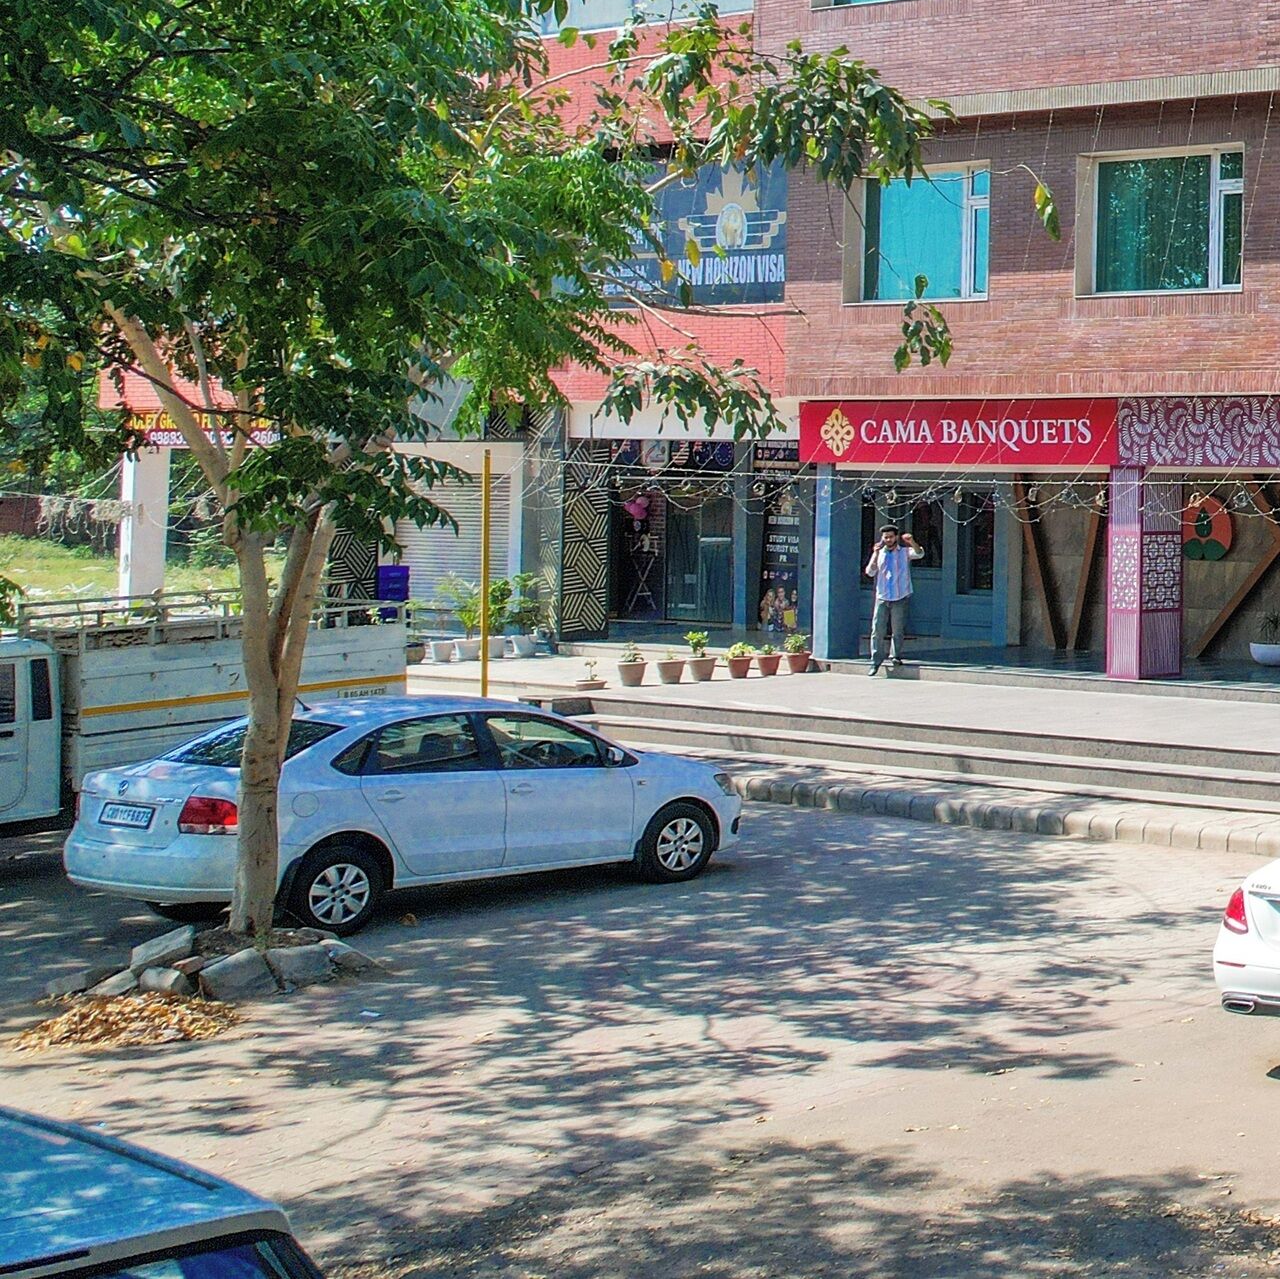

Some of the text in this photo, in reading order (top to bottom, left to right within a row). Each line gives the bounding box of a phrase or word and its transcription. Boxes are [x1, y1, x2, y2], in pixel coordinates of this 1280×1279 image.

[677, 260, 704, 286] NEW
[705, 256, 755, 285] HORIZON
[757, 254, 785, 283] VISA
[860, 419, 1092, 452] CAMA BANQUETS
